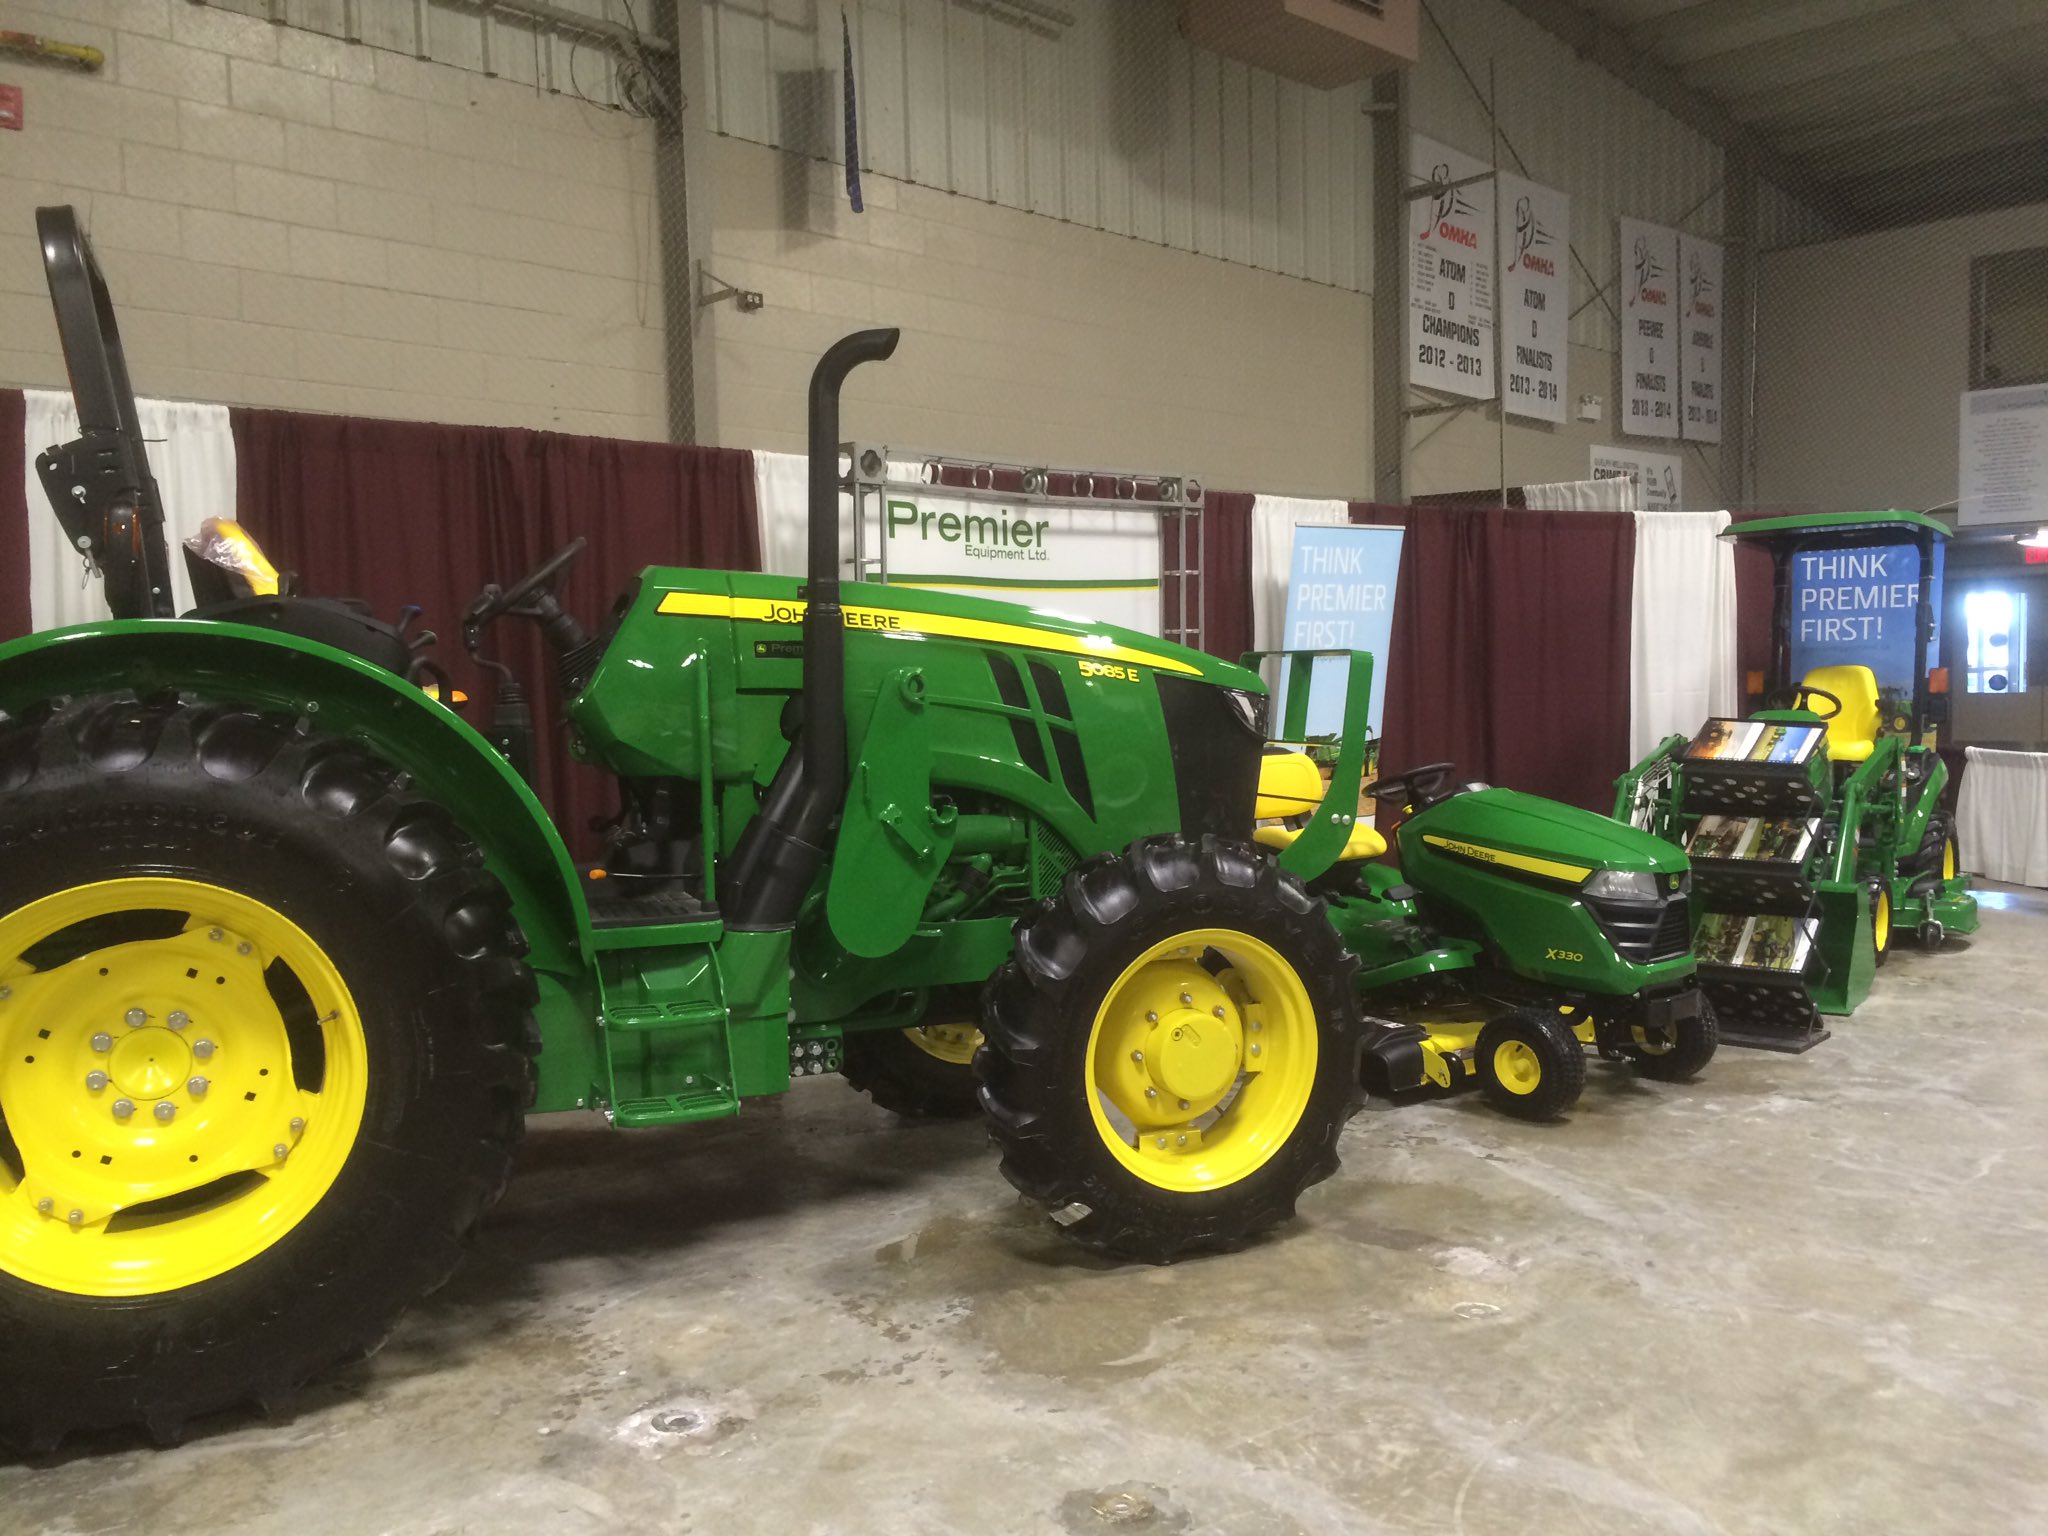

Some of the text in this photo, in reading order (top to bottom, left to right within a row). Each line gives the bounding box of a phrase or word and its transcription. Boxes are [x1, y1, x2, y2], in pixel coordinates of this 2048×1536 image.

[1439, 222, 1478, 249] OMHA
[1439, 258, 1466, 284] ATOM
[1523, 288, 1546, 312] ATOM
[1422, 313, 1480, 347] CHAMPIONS
[1418, 344, 1446, 369] 2012
[1456, 354, 1482, 377] 2013
[1516, 344, 1553, 372] FINALISTS
[1510, 373, 1531, 396] 2013
[1538, 380, 1558, 402] 2014
[887, 500, 1050, 548] Premier
[965, 544, 1050, 561] Equipment Ltd.
[1301, 546, 1364, 575] THINK
[1801, 553, 1888, 580] THINK
[1296, 583, 1387, 612] PREMIER
[1801, 583, 1919, 612] PREMIER
[764, 603, 901, 630] JOH EERE
[1801, 616, 1882, 642] FIRST!
[771, 643, 804, 653] Prem
[1293, 620, 1355, 650] FIRST!
[1078, 660, 1140, 683] 5085 E
[1445, 840, 1496, 862] JOHN DEERE
[1545, 948, 1584, 962] X330
